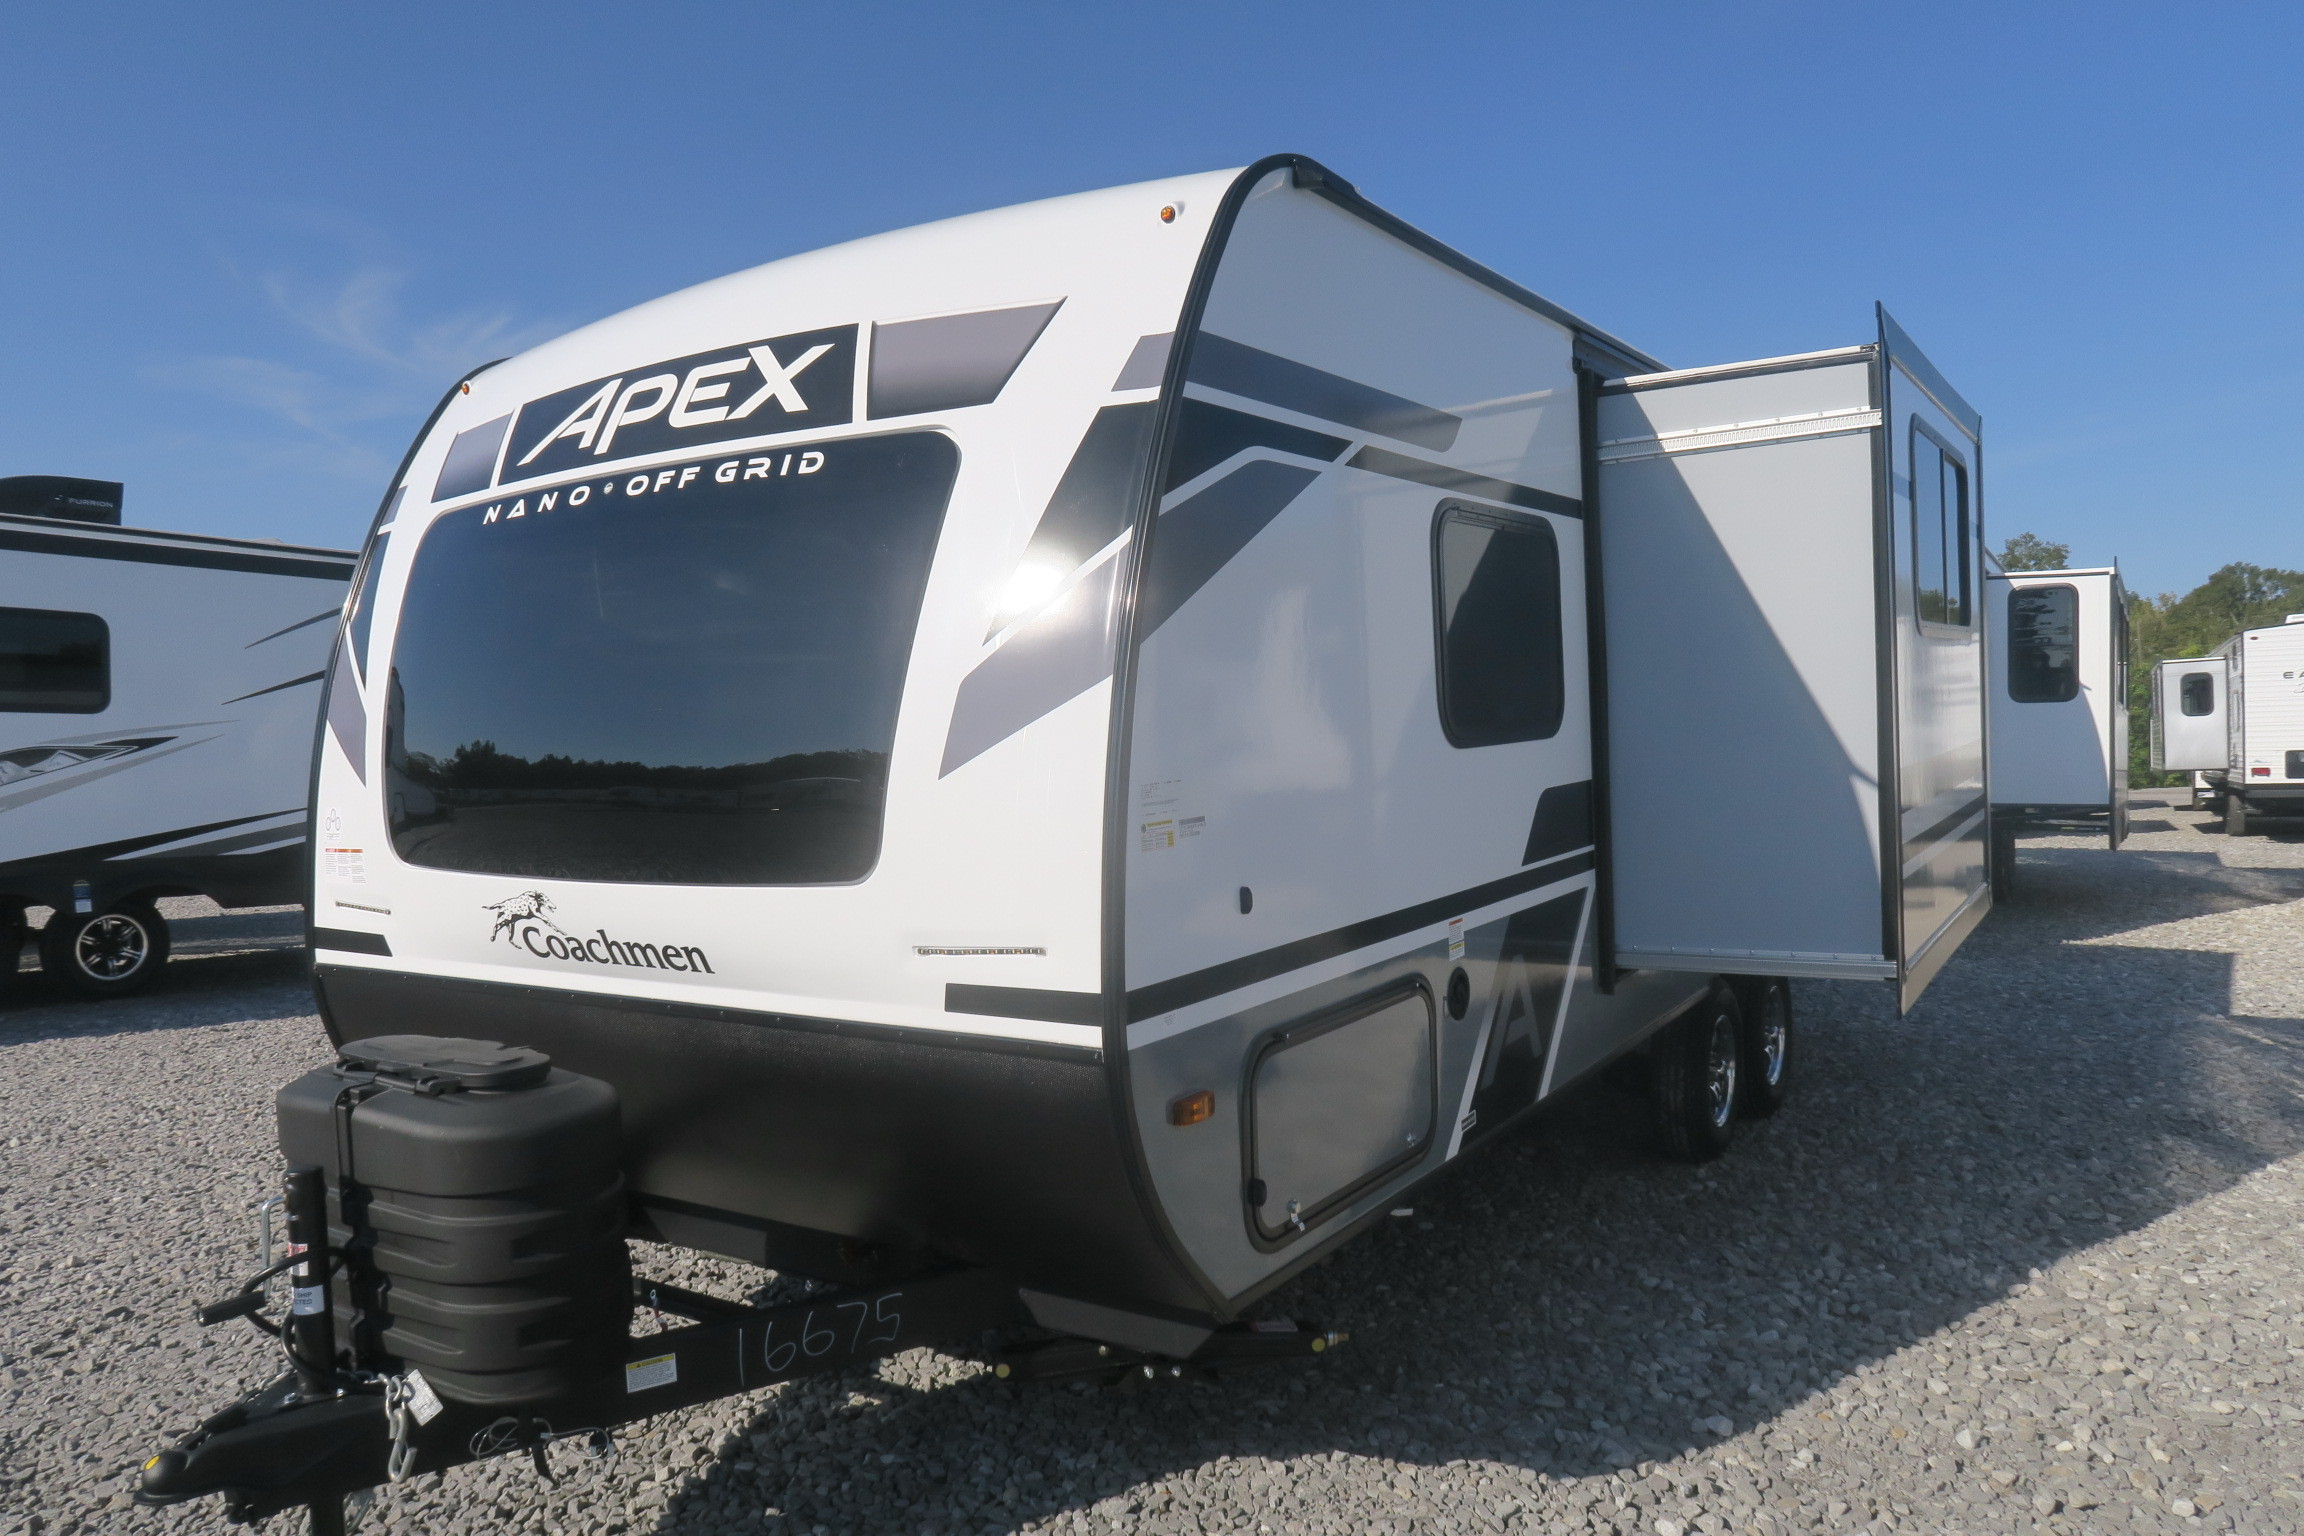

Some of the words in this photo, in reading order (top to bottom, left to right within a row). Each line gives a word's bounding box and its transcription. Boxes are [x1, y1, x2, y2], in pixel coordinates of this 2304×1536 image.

[516, 343, 836, 467] APEX
[67, 497, 114, 508] FURRION
[482, 485, 592, 525] NANO
[626, 466, 702, 496] OFF
[714, 451, 826, 484] GRID
[522, 925, 716, 975] Coachmen
[737, 1292, 904, 1388] 16675
